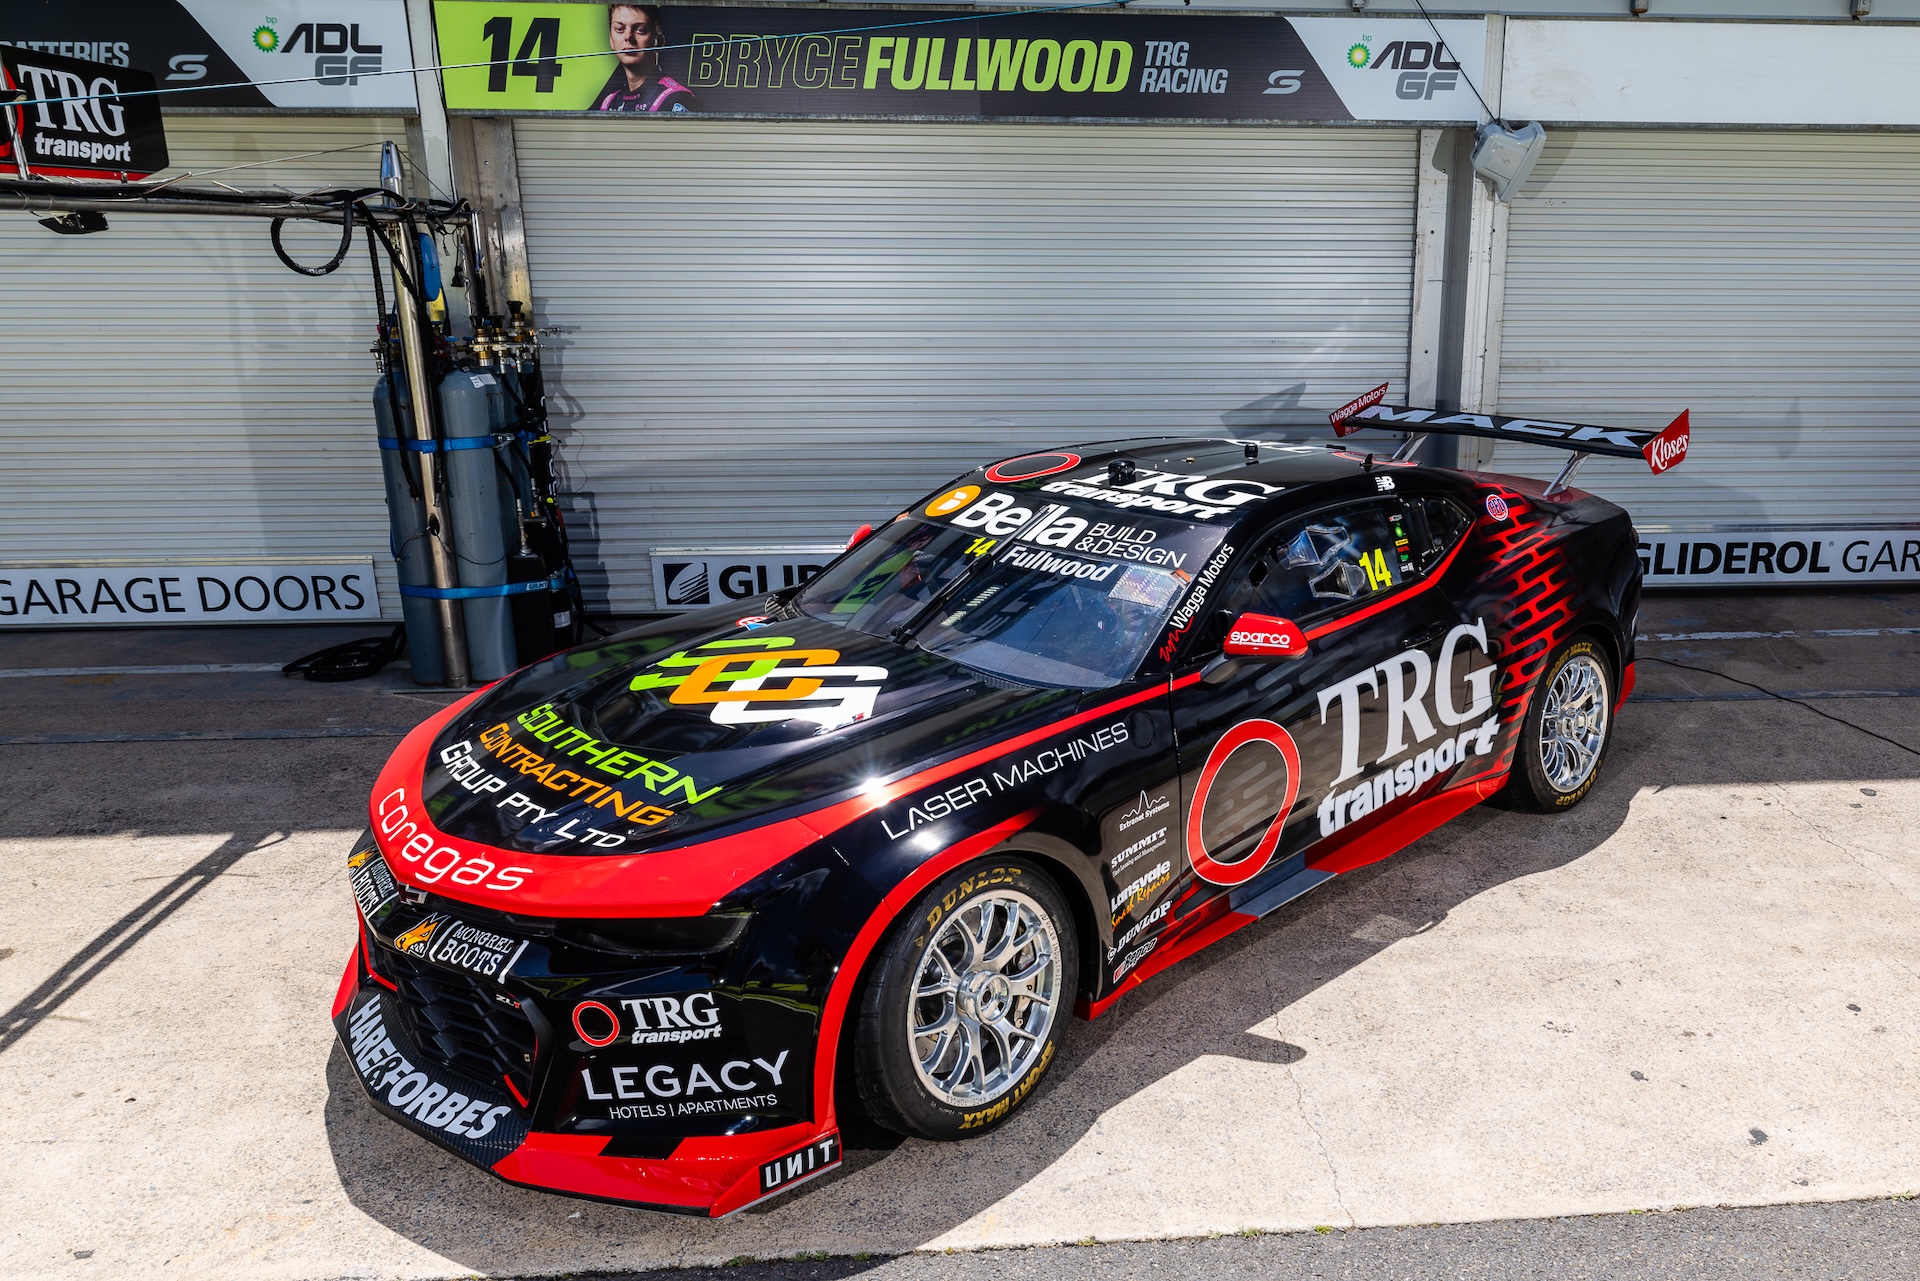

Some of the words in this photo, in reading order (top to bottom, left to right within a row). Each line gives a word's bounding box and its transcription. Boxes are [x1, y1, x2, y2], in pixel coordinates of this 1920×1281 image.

[265, 15, 278, 25] bp
[280, 23, 383, 54] ADL
[1362, 34, 1373, 42] bp
[0, 41, 129, 68] ERIES
[315, 55, 382, 86] GF
[482, 16, 563, 93] 14
[687, 33, 862, 90] BRYCE
[863, 36, 1133, 93] FULLWOOD
[1144, 40, 1189, 67] TRG
[1369, 40, 1461, 70] ADL
[1140, 67, 1228, 94] RACING
[1396, 71, 1459, 100] GF
[17, 64, 126, 137] TRG
[34, 131, 132, 164] transport
[1330, 402, 1358, 423] Wagga
[1358, 387, 1386, 408] Motors
[1353, 405, 1652, 448] MACK
[1040, 480, 1236, 519] transport
[1071, 467, 1286, 507] TRG
[950, 491, 1089, 549] Bella
[1087, 521, 1157, 546] BUILD
[964, 537, 997, 556] 14
[999, 544, 1118, 582] Fullwood
[1169, 585, 1208, 630] Wagga
[1198, 543, 1235, 588] Motors
[1359, 548, 1392, 591] 14
[197, 574, 365, 612] DOORS
[1229, 630, 1291, 647] sparco
[1316, 616, 1498, 788] TRG
[517, 703, 724, 805] SOUTHERN
[479, 722, 674, 826] CONTRACTING
[881, 777, 993, 841] LASER
[992, 721, 1129, 792] MACHINES
[1316, 713, 1501, 838] transport
[440, 740, 507, 795] GROUP
[496, 791, 559, 825] PTY
[554, 818, 627, 849] LTD
[1119, 812, 1145, 832] Extranet
[1144, 801, 1170, 818] Systems
[1111, 826, 1168, 869] SUMMIT
[926, 867, 1022, 933] DUNLOP
[452, 924, 514, 954] MONGREL
[1117, 900, 1172, 953] DUNLOP
[437, 938, 504, 976] BOOTS
[621, 992, 720, 1030] TRG
[631, 1024, 722, 1045] transport
[581, 1050, 790, 1100] LEGACY
[609, 1103, 666, 1120] HOTELS
[678, 1094, 778, 1115] APARTMENTS
